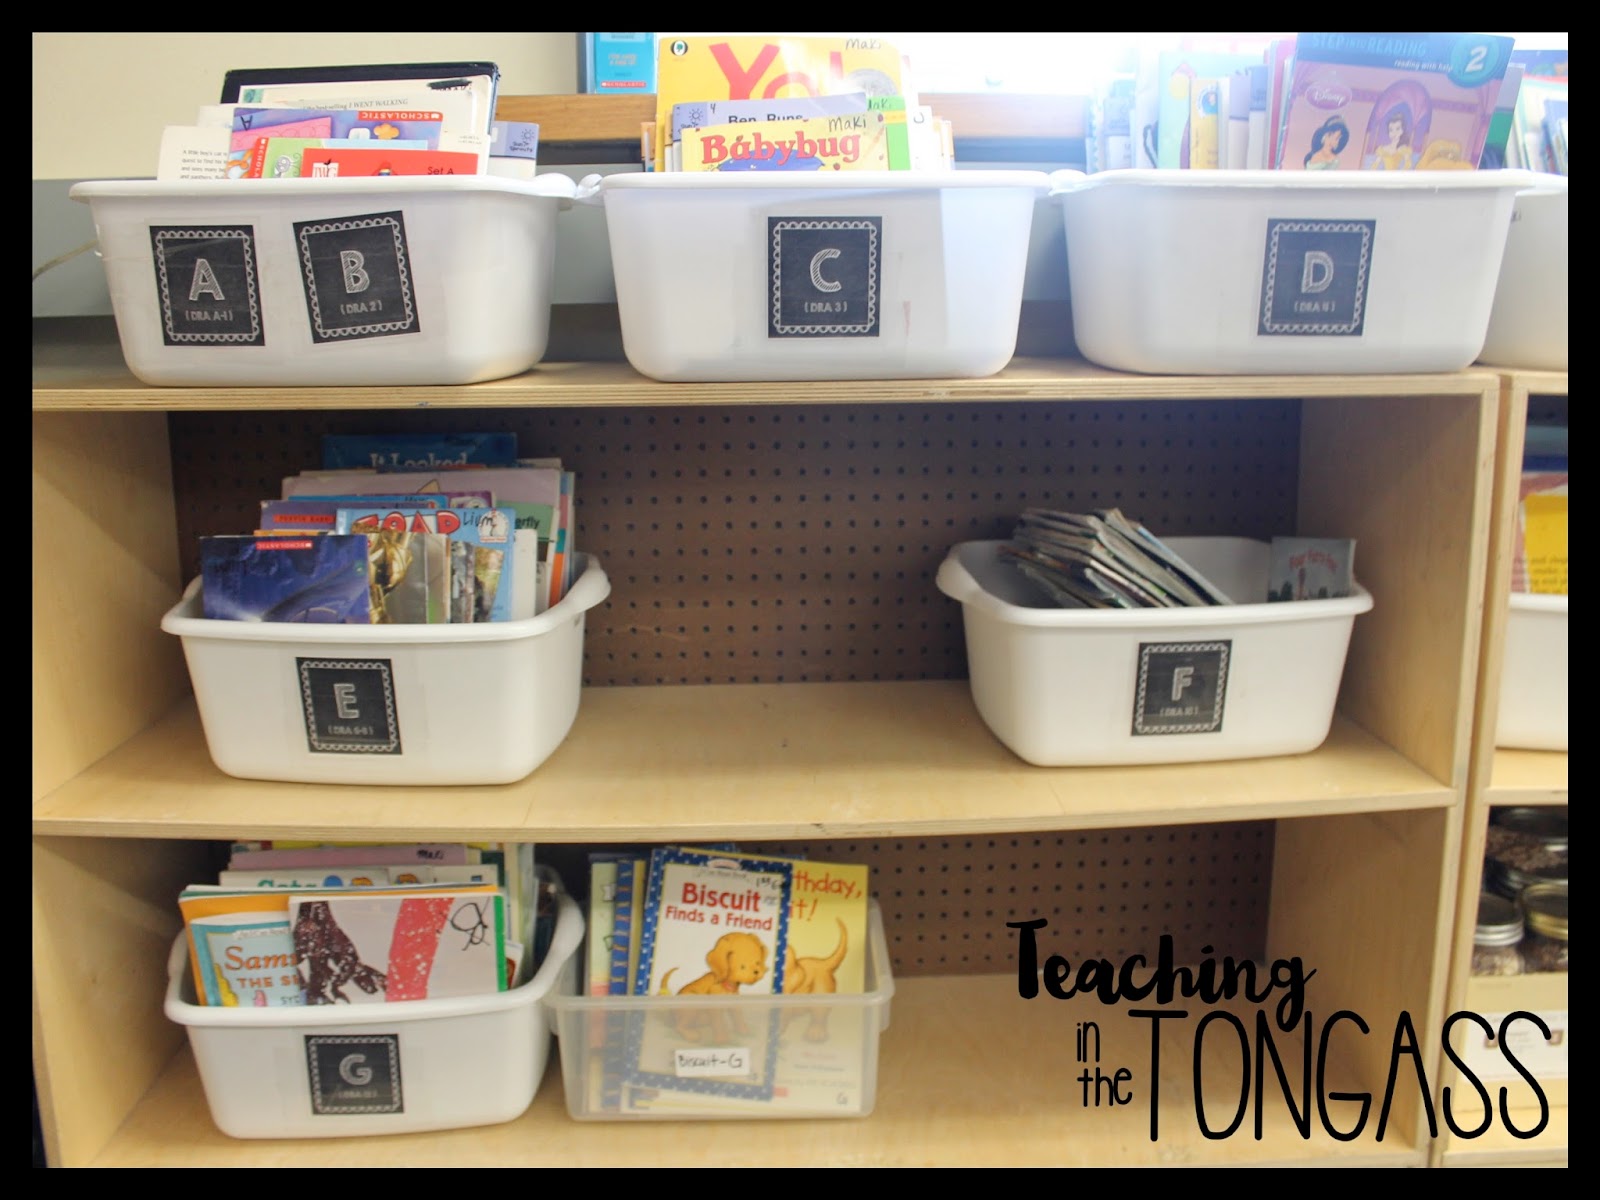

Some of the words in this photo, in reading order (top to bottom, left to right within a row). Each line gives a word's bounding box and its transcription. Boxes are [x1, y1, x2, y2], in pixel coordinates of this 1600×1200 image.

[1464, 45, 1489, 73] 2
[353, 100, 375, 108] WENT
[376, 98, 408, 107] WALKING
[361, 112, 430, 120] SCHOLASTIC
[700, 130, 861, 166] Babybug
[189, 258, 225, 301] A
[340, 250, 370, 294] B
[810, 248, 842, 293] C
[1301, 251, 1334, 294] D
[333, 683, 360, 719] E
[1171, 667, 1195, 702] F
[681, 882, 761, 913] Biscuit
[665, 905, 705, 924] Finds
[710, 911, 719, 925] a
[725, 915, 773, 931] Friend
[237, 976, 274, 989] THE
[339, 1053, 373, 1086] G
